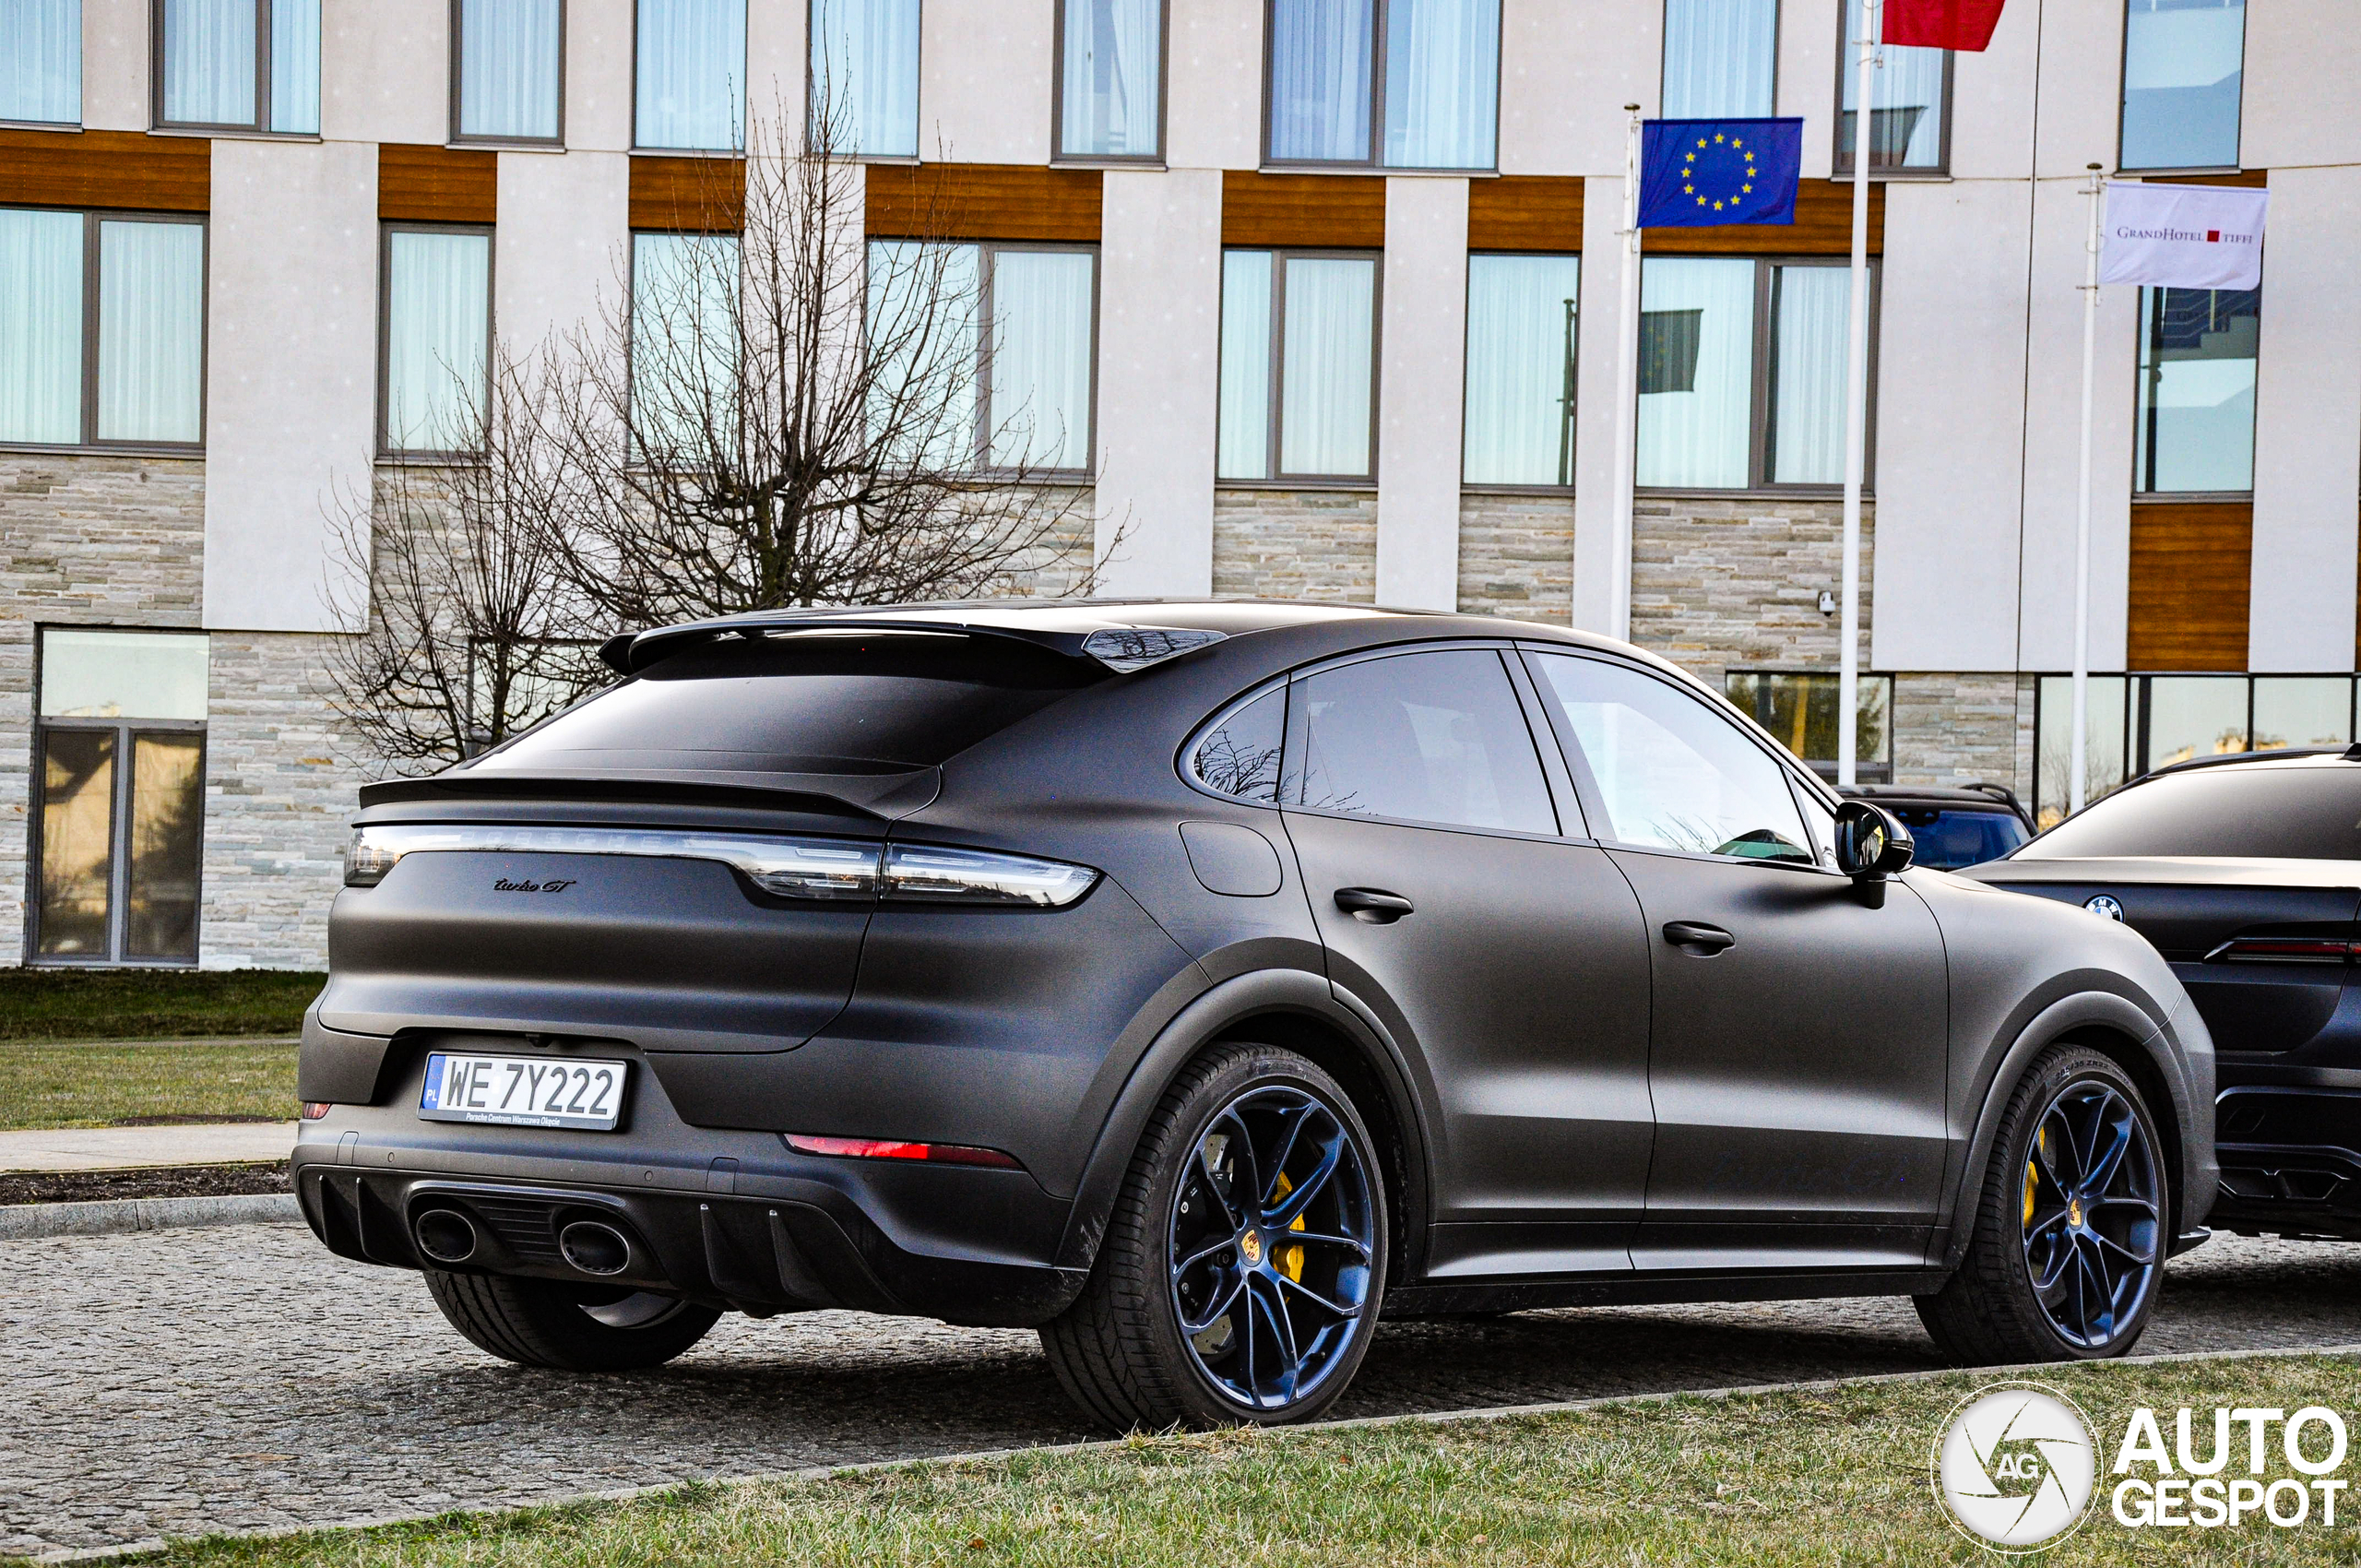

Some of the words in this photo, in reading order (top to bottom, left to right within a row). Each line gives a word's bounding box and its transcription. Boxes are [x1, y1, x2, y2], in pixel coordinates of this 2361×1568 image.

[493, 878, 539, 892] turbo
[540, 879, 577, 893] GT
[2087, 898, 2118, 913] BMW
[425, 1088, 437, 1101] PL
[446, 1061, 492, 1108] WE
[500, 1063, 613, 1115] 7Y222
[466, 1112, 488, 1122] Porsche
[488, 1113, 512, 1123] Centrum
[512, 1115, 540, 1124] Warszawa
